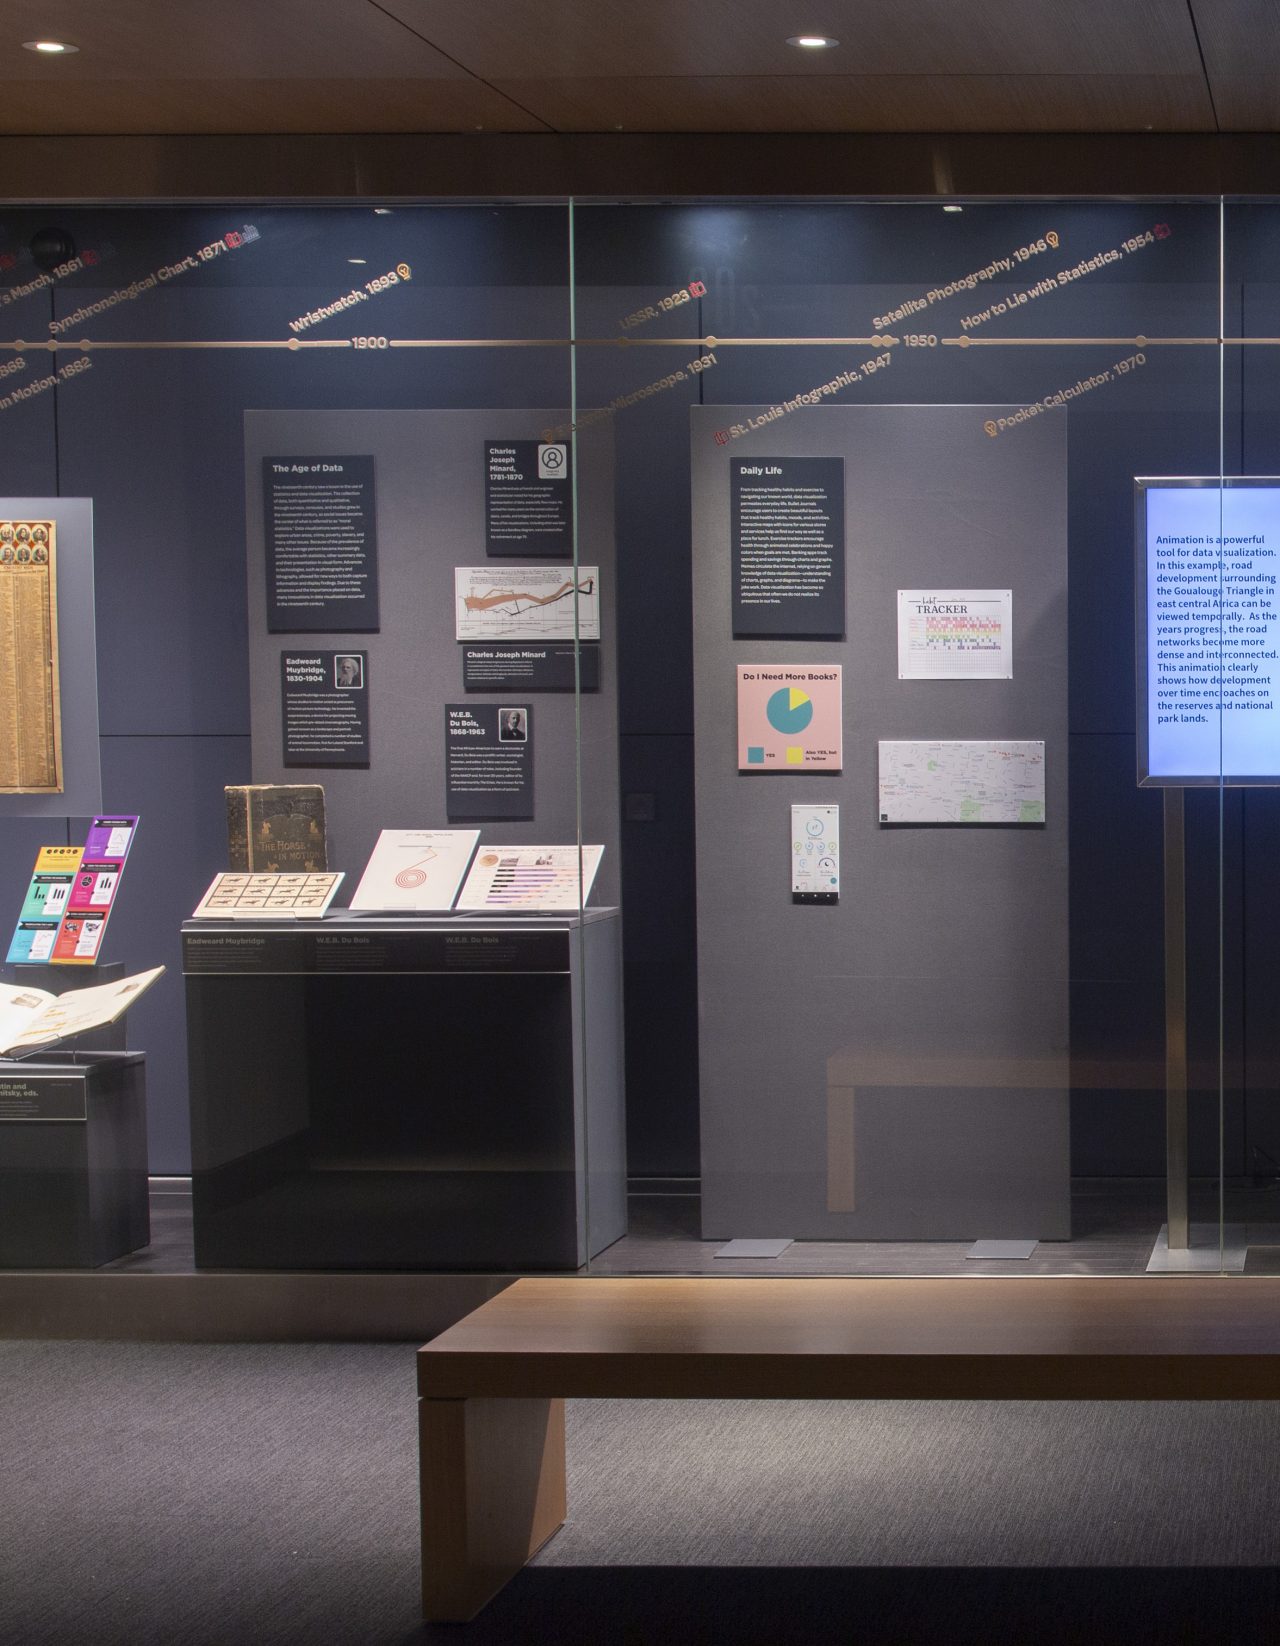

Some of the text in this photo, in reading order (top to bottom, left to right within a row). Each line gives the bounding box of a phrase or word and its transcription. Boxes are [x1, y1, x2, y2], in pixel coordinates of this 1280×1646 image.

[9, 273, 55, 300] March,
[53, 256, 83, 279] 1861
[960, 230, 1155, 330] How to Lie with Statistics, 1954
[48, 240, 229, 334] Synchronological Chart, 1871
[872, 238, 1048, 330] Satellite Photography, 1946
[289, 271, 400, 333] Wristwatch, 1893
[619, 289, 690, 330] USSR, 1923
[351, 336, 388, 349] 1900
[903, 334, 938, 347] 1950
[11, 375, 60, 402] Motion,
[59, 356, 92, 379] 1882
[611, 352, 717, 410] Microscope, 1931
[729, 352, 893, 439] St. Louis Infographic, 1947
[997, 352, 1146, 431] Pocket Calculator, 1970
[292, 465, 309, 473] Age
[311, 464, 320, 472] of
[323, 464, 343, 472] Data
[740, 467, 763, 476] Daily
[1156, 535, 1204, 544] Animation
[1207, 535, 1213, 544] is
[1224, 535, 1265, 546] powerful
[1156, 548, 1276, 557] tool for data vsualization.
[1157, 562, 1165, 570] In
[1168, 562, 1184, 570] this
[1232, 562, 1252, 570] road
[1157, 574, 1217, 585] development
[1157, 587, 1172, 595] the
[1227, 587, 1264, 598] Triangle
[1266, 587, 1274, 595] in
[916, 605, 967, 613] TRACKER
[1179, 600, 1210, 608] central
[1260, 600, 1271, 608] be
[1157, 612, 1277, 623] viewed temporally. As the
[1157, 627, 1181, 636] years
[1157, 638, 1200, 646] networks
[1203, 638, 1239, 646] become
[1157, 651, 1279, 659] dense and interconnected.
[1158, 664, 1258, 674] This animation clearly
[1157, 676, 1271, 687] shows how development
[1180, 689, 1201, 697] time
[1158, 702, 1173, 710] the
[1216, 702, 1232, 710] and
[1235, 702, 1273, 710] national
[1158, 714, 1208, 724] park lands.
